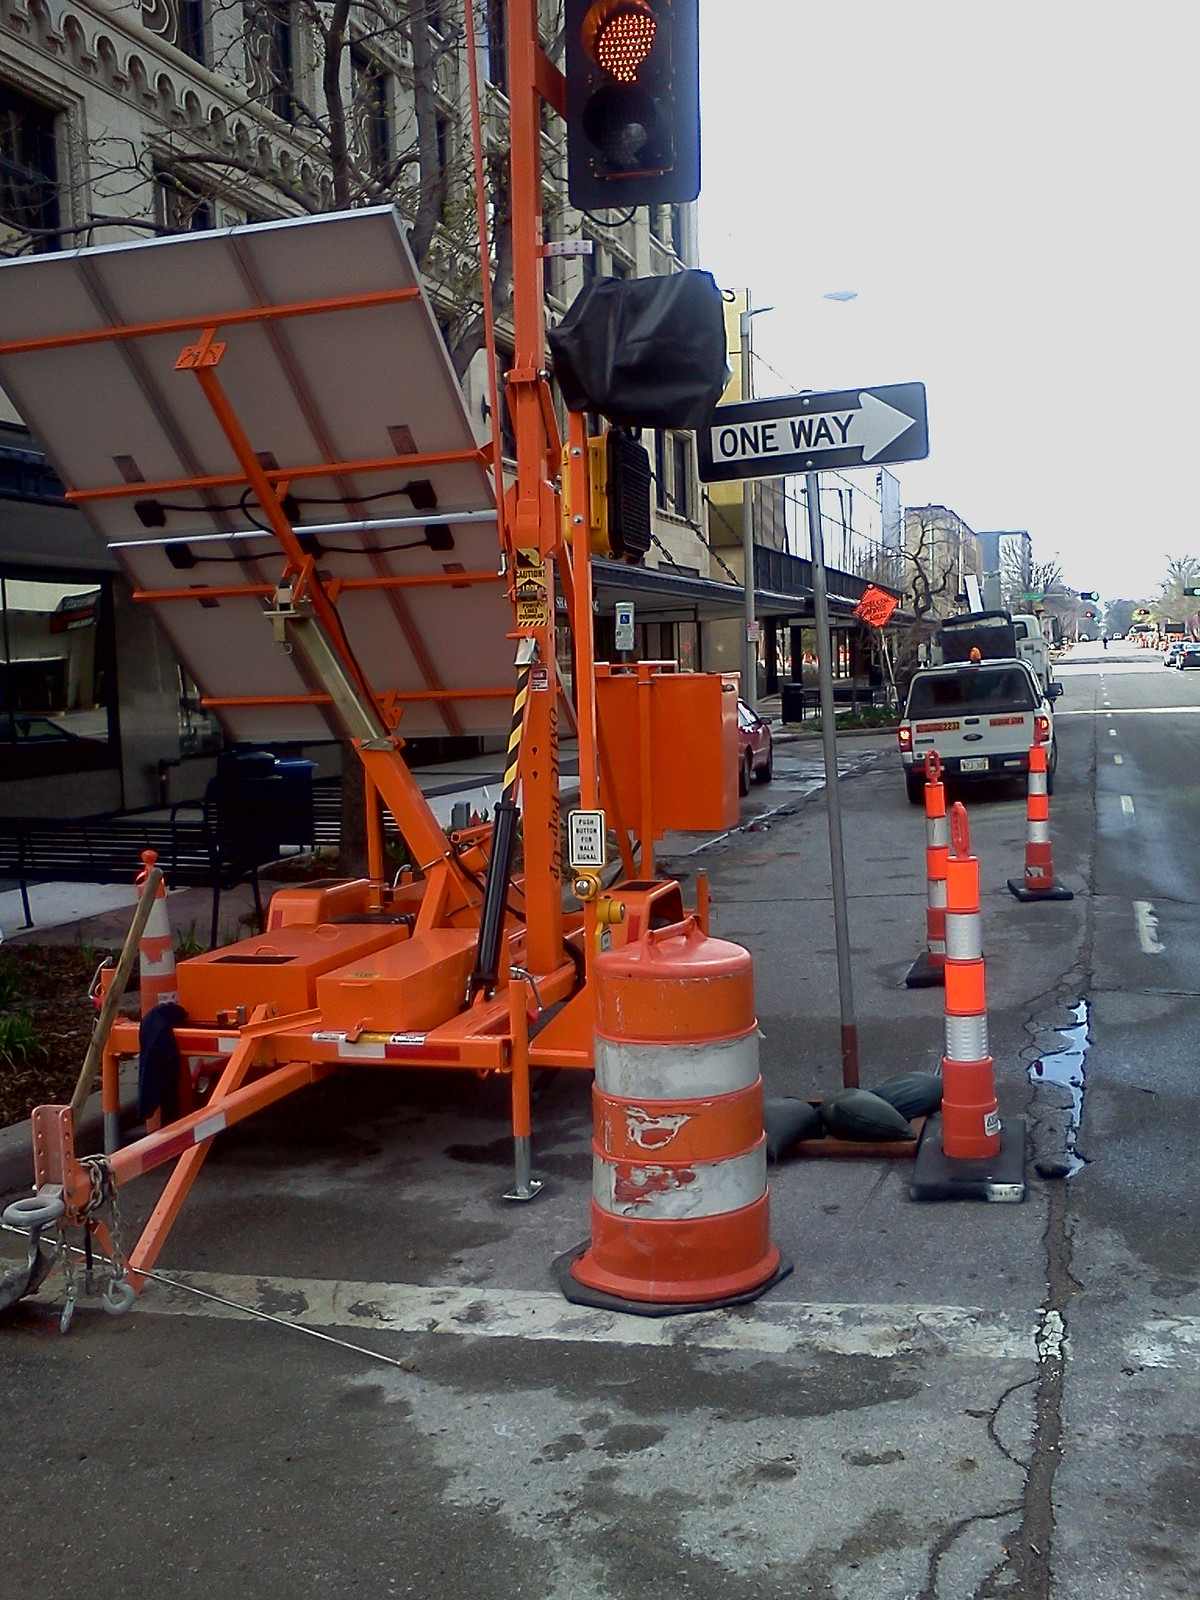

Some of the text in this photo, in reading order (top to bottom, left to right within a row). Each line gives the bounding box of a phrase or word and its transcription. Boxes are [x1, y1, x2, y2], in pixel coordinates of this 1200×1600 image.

[719, 414, 854, 458] ONE WAY
[516, 570, 545, 579] CAUTION!
